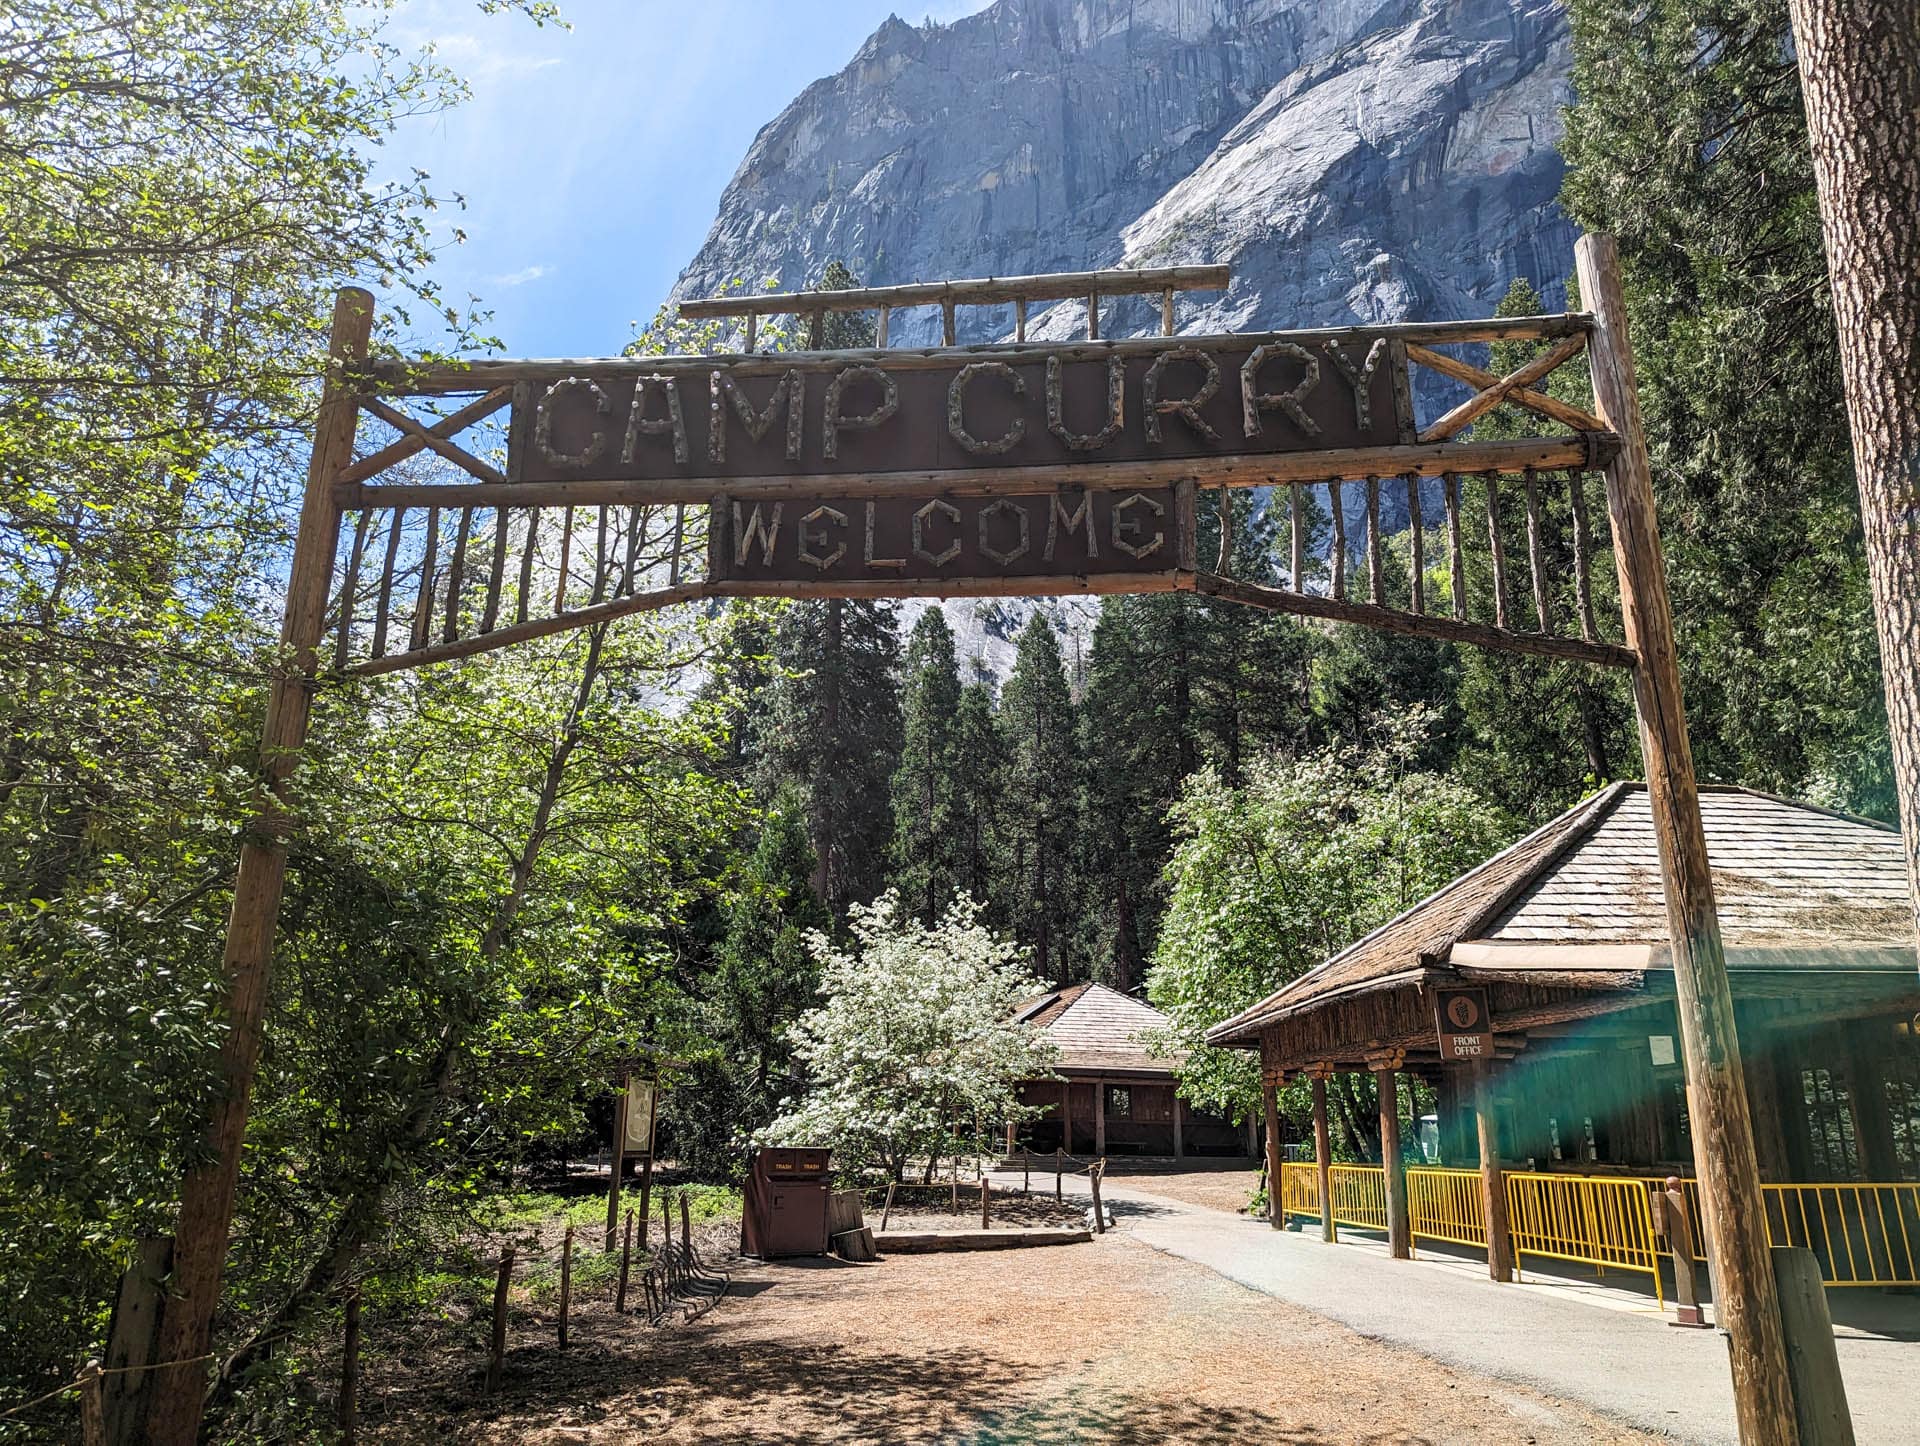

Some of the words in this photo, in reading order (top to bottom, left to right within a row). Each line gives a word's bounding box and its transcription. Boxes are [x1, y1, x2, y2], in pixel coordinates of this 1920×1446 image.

[535, 364, 899, 469] CAMP
[947, 337, 1387, 455] CURRY
[733, 489, 1164, 572] WELCOME
[1453, 1036, 1480, 1046] FRONT
[1454, 1046, 1483, 1056] OFFICE
